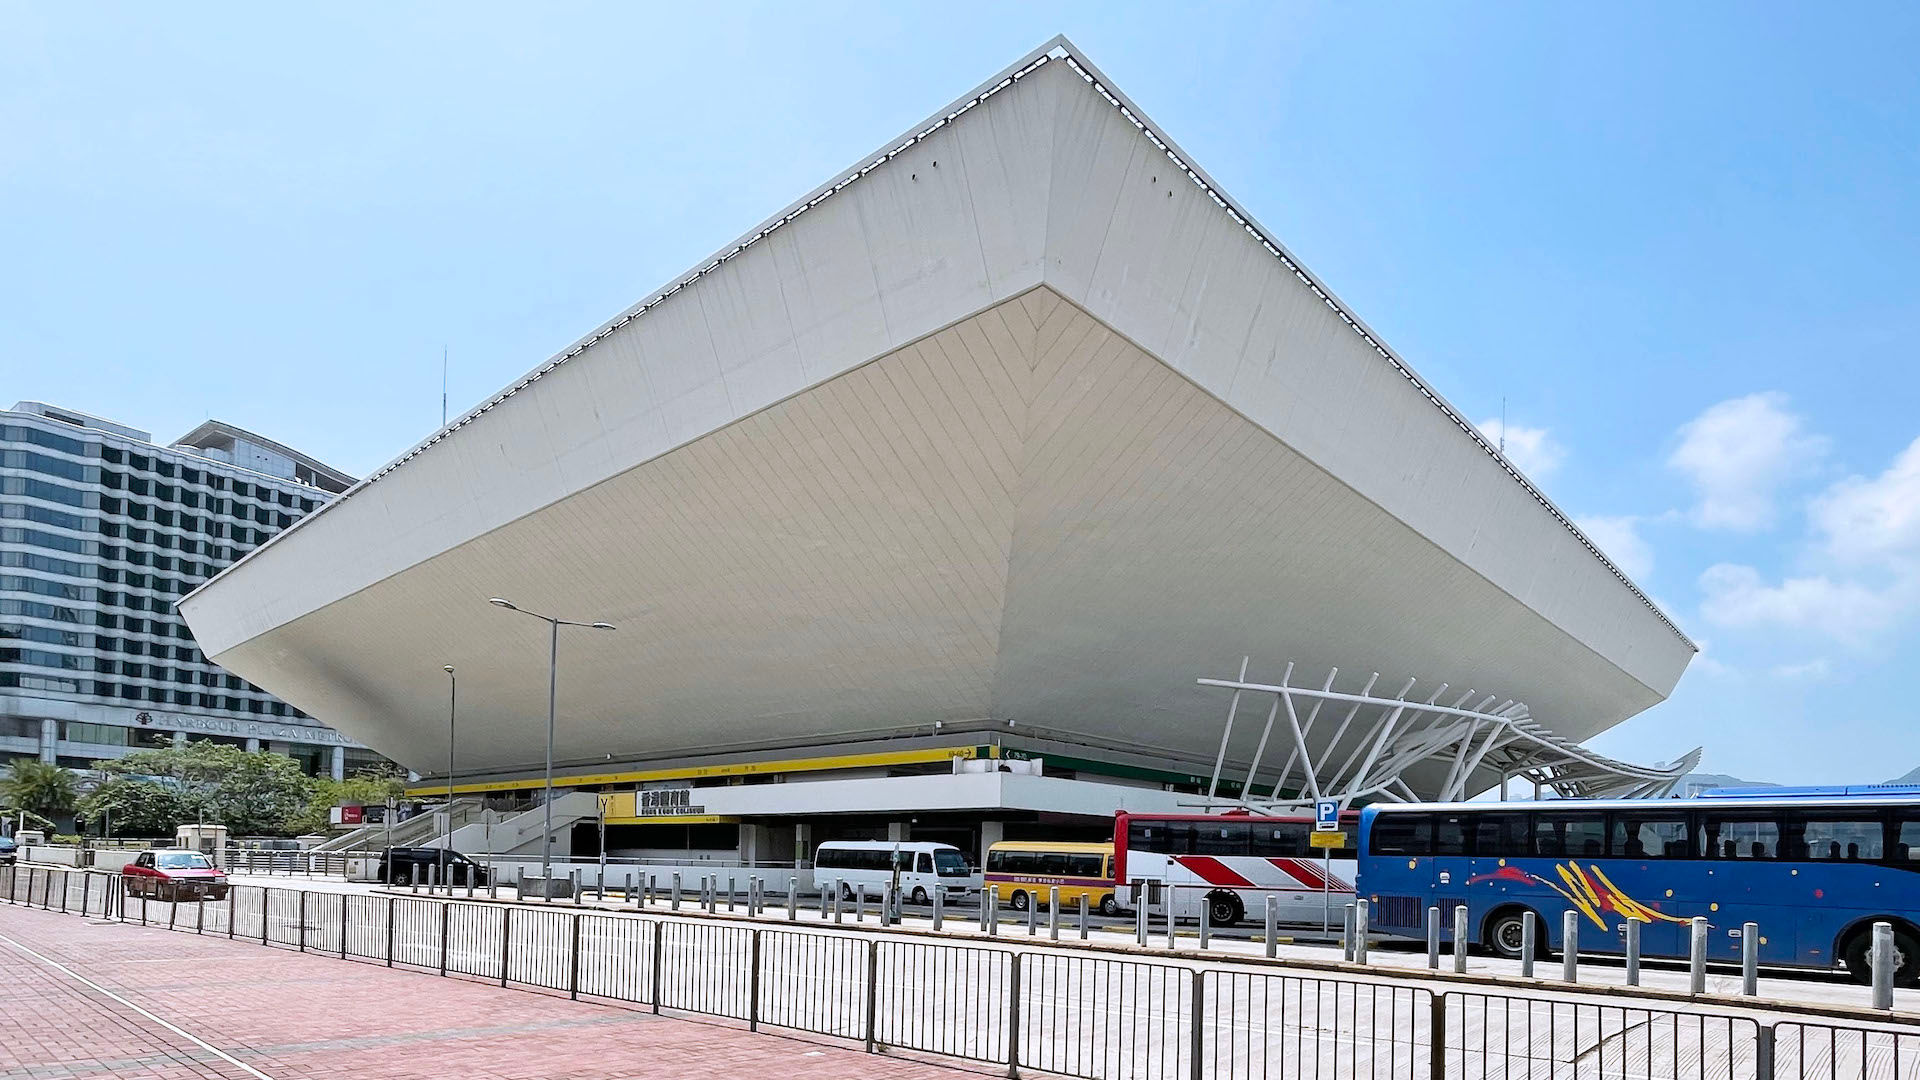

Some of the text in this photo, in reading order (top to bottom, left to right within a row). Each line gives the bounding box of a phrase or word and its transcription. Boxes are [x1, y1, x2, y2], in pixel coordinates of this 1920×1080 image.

[156, 715, 239, 733] HARBOUR
[248, 723, 298, 738] PLAZA
[676, 806, 705, 814] COLISEUM
[1320, 803, 1335, 821] P
